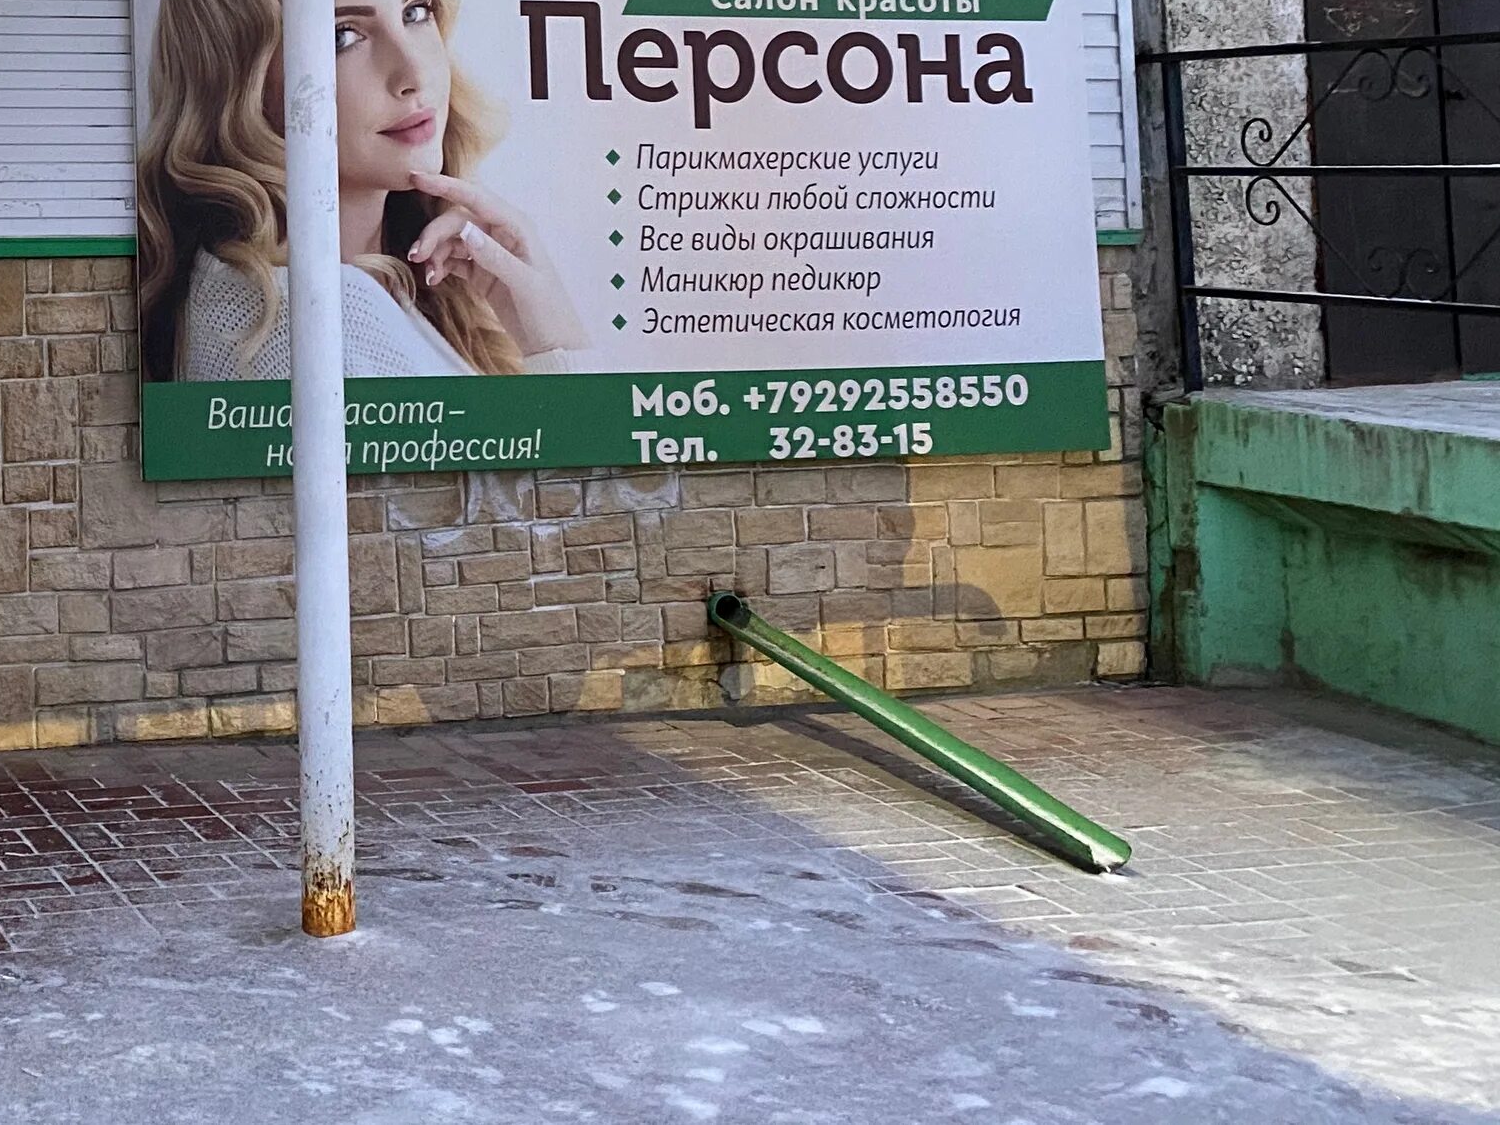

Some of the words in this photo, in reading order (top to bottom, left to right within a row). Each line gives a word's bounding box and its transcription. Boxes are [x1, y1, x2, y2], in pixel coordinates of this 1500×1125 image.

[520, 0, 1034, 129] Персона
[636, 143, 851, 176] Парикмахерские
[858, 148, 939, 176] услуги
[637, 184, 759, 217] Стрижки
[766, 183, 848, 210] любой
[855, 186, 996, 210] сложности
[640, 225, 683, 251] Все
[691, 224, 755, 251] виды
[764, 228, 934, 257] окрашивания
[640, 266, 764, 298] Маникюр
[771, 264, 881, 297] педикюр
[641, 307, 835, 334] Эстетическая
[842, 307, 1021, 333] косметология
[631, 379, 731, 417] Моб.
[743, 374, 1029, 414] +79292558550
[362, 428, 542, 472] профессия!
[631, 431, 718, 464] Тел.
[769, 422, 934, 460] 32-83-15
